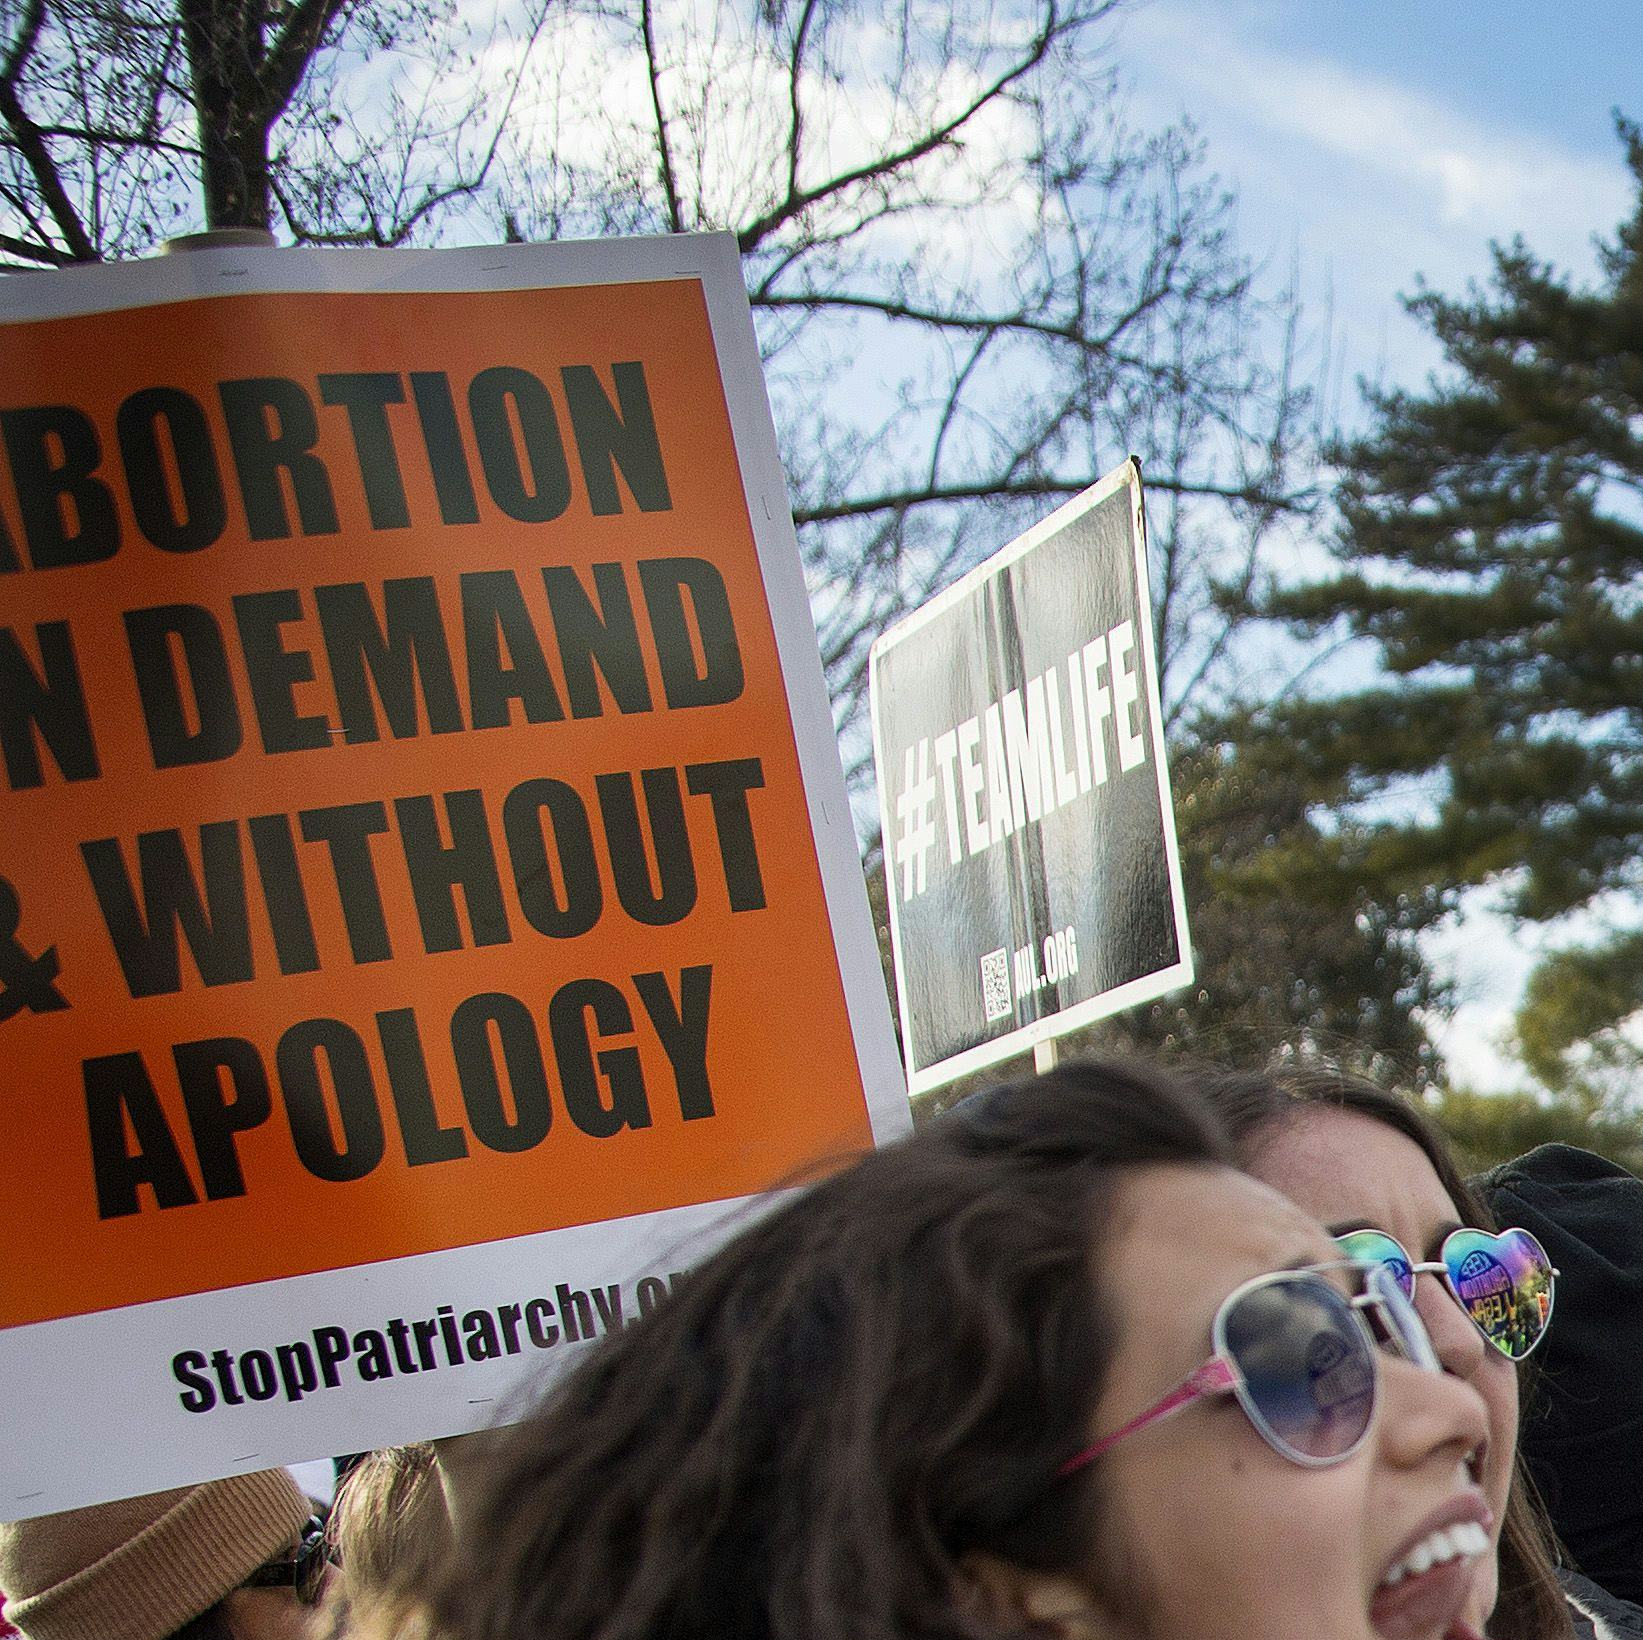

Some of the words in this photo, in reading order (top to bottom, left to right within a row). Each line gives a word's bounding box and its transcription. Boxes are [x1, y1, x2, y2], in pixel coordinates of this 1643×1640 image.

[123, 555, 747, 770] DEMAND
[897, 620, 1145, 901] #TEAMLIFE
[79, 757, 768, 1000] WITHOUT
[81, 964, 717, 1221] APOLOGY
